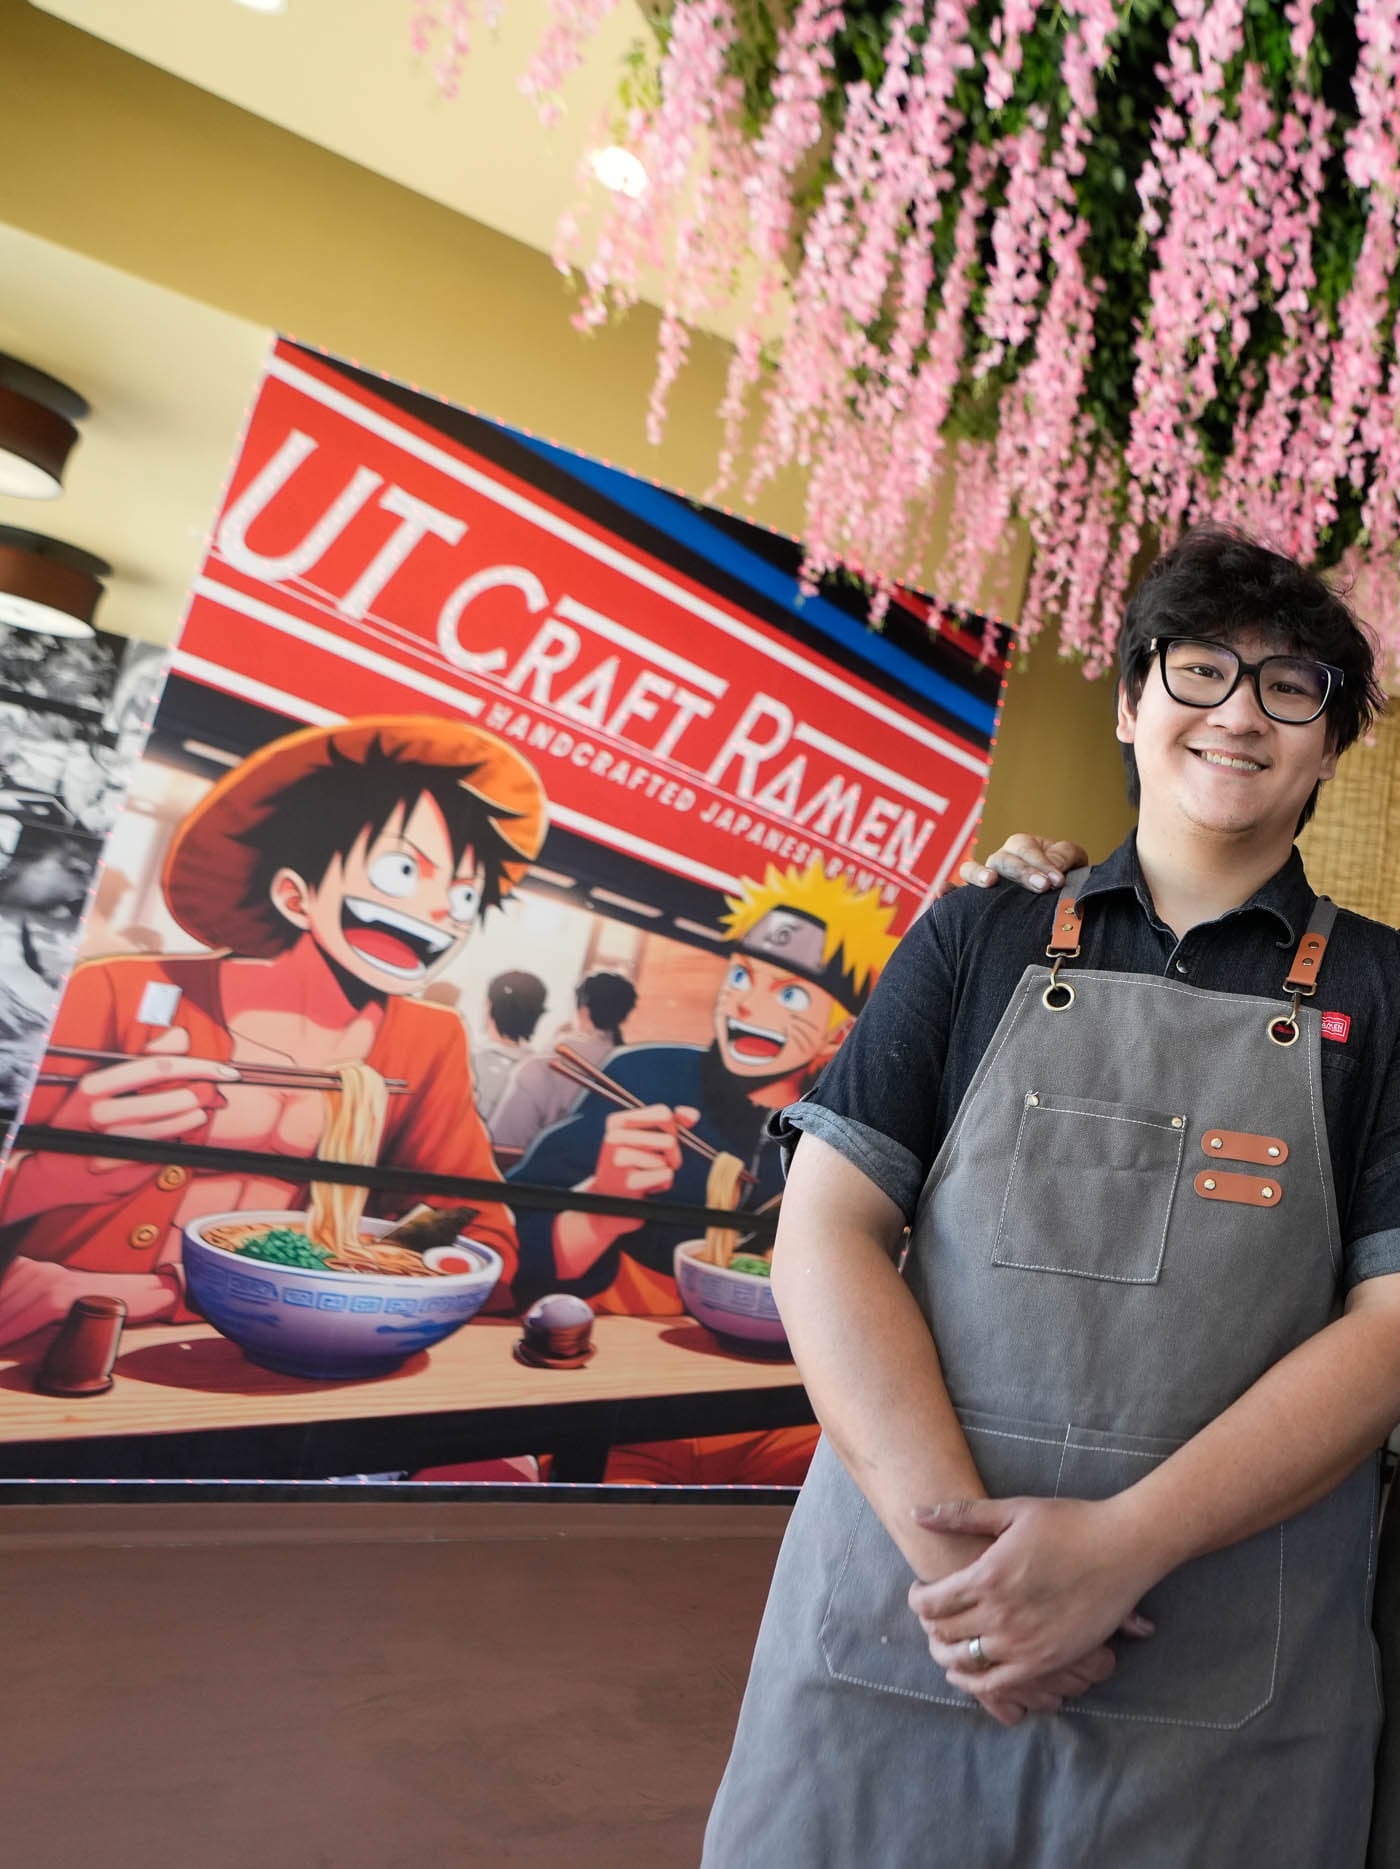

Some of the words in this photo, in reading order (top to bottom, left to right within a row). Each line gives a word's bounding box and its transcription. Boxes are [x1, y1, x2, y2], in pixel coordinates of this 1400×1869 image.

[218, 428, 469, 621] UT
[437, 564, 716, 759] CRAFT
[706, 691, 937, 876] RAMEN
[485, 702, 697, 812] HANDCRAFTED
[1321, 1022, 1344, 1031] AMEN
